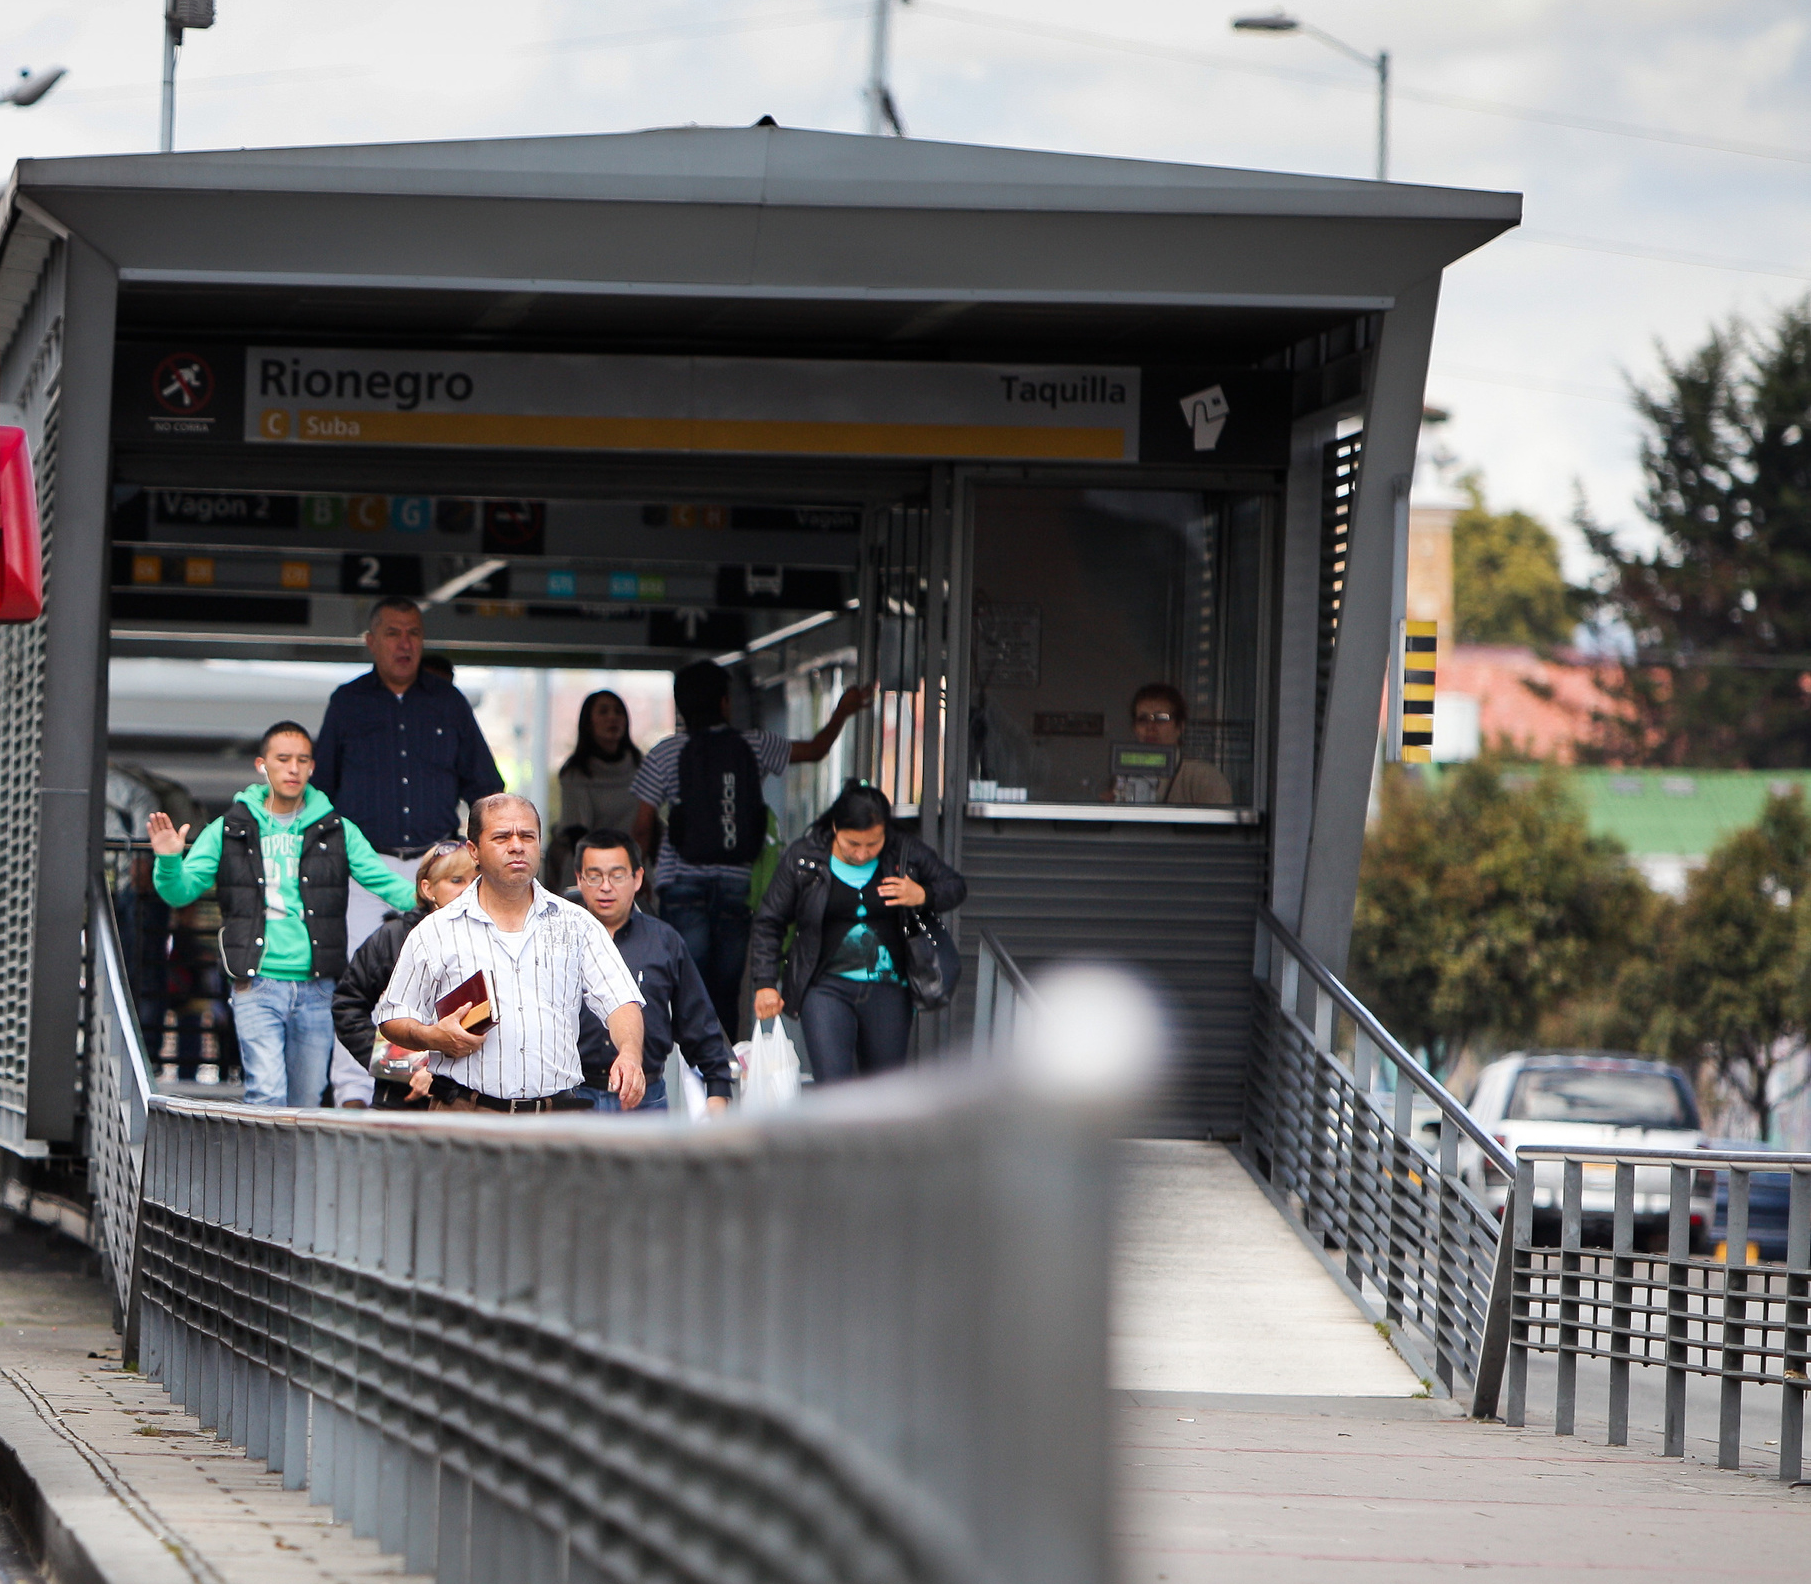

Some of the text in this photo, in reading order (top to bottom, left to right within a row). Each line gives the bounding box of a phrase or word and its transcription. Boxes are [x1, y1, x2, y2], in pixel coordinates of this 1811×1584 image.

[259, 358, 474, 410] Rionegro
[999, 374, 1127, 410] Taquilla
[154, 422, 172, 434] NO
[266, 413, 361, 438] C Suba
[162, 491, 271, 522] Vagón 2
[313, 499, 333, 525] B
[400, 499, 421, 525] G
[357, 557, 382, 590] 2
[719, 771, 738, 852] adidas
